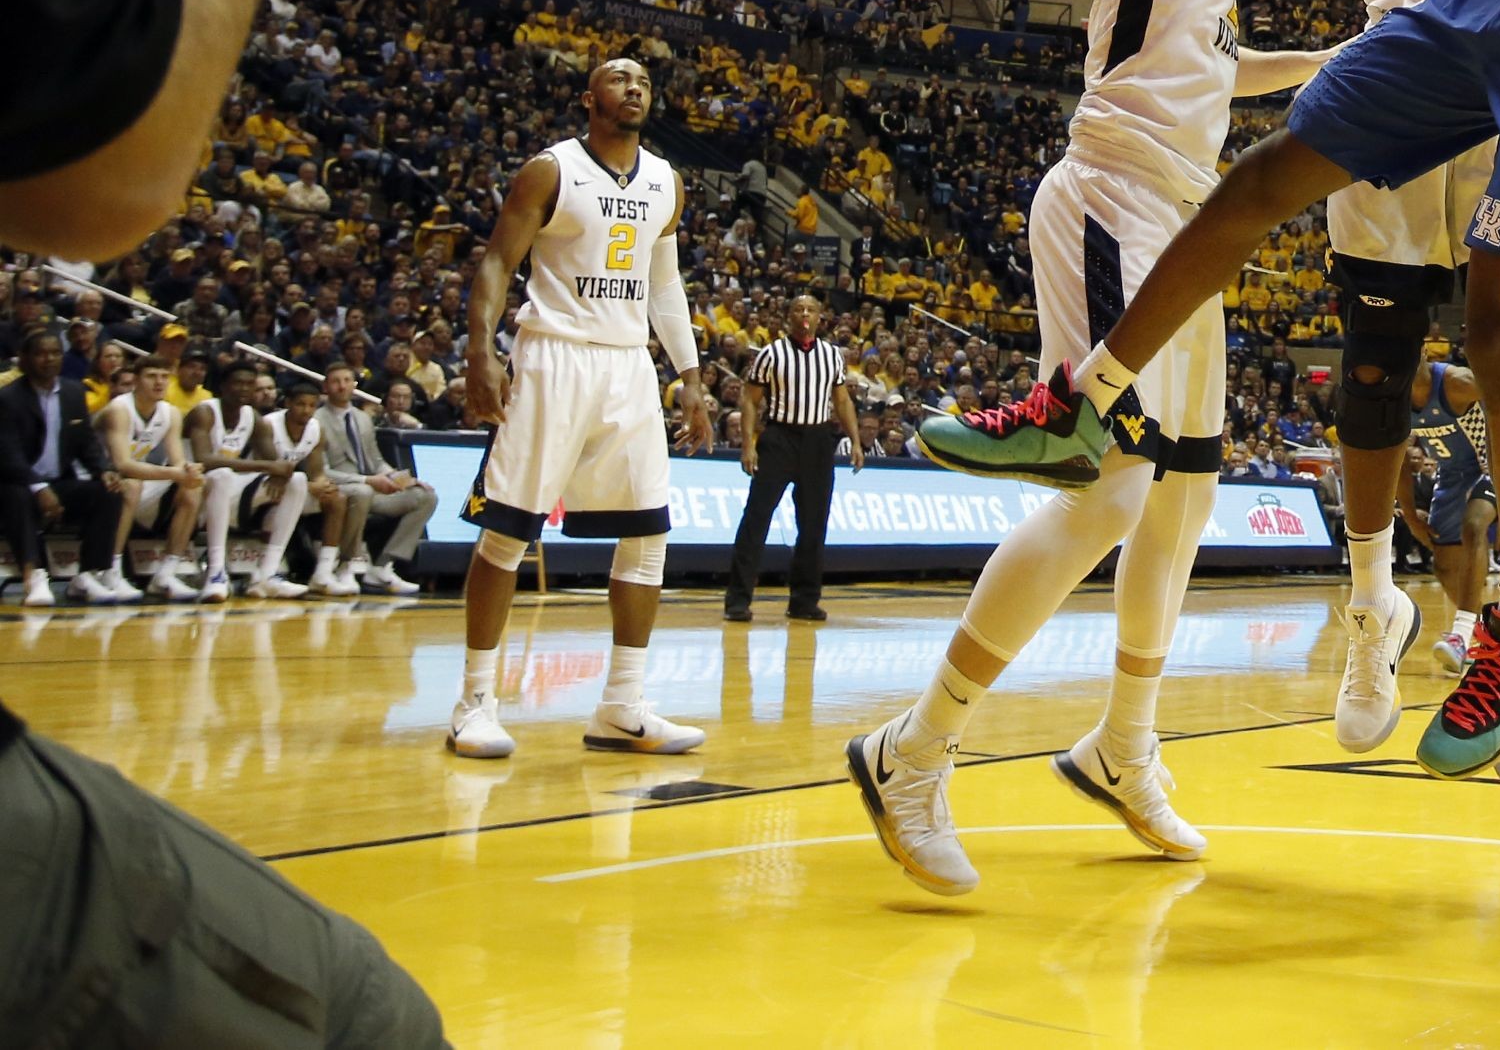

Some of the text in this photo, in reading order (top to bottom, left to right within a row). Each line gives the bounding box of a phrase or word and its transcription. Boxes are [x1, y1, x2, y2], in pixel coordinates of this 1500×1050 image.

[598, 196, 650, 222] WEST
[606, 222, 637, 271] 2
[1428, 438, 1451, 458] 3
[827, 489, 1016, 533] NGREDIENTS.
